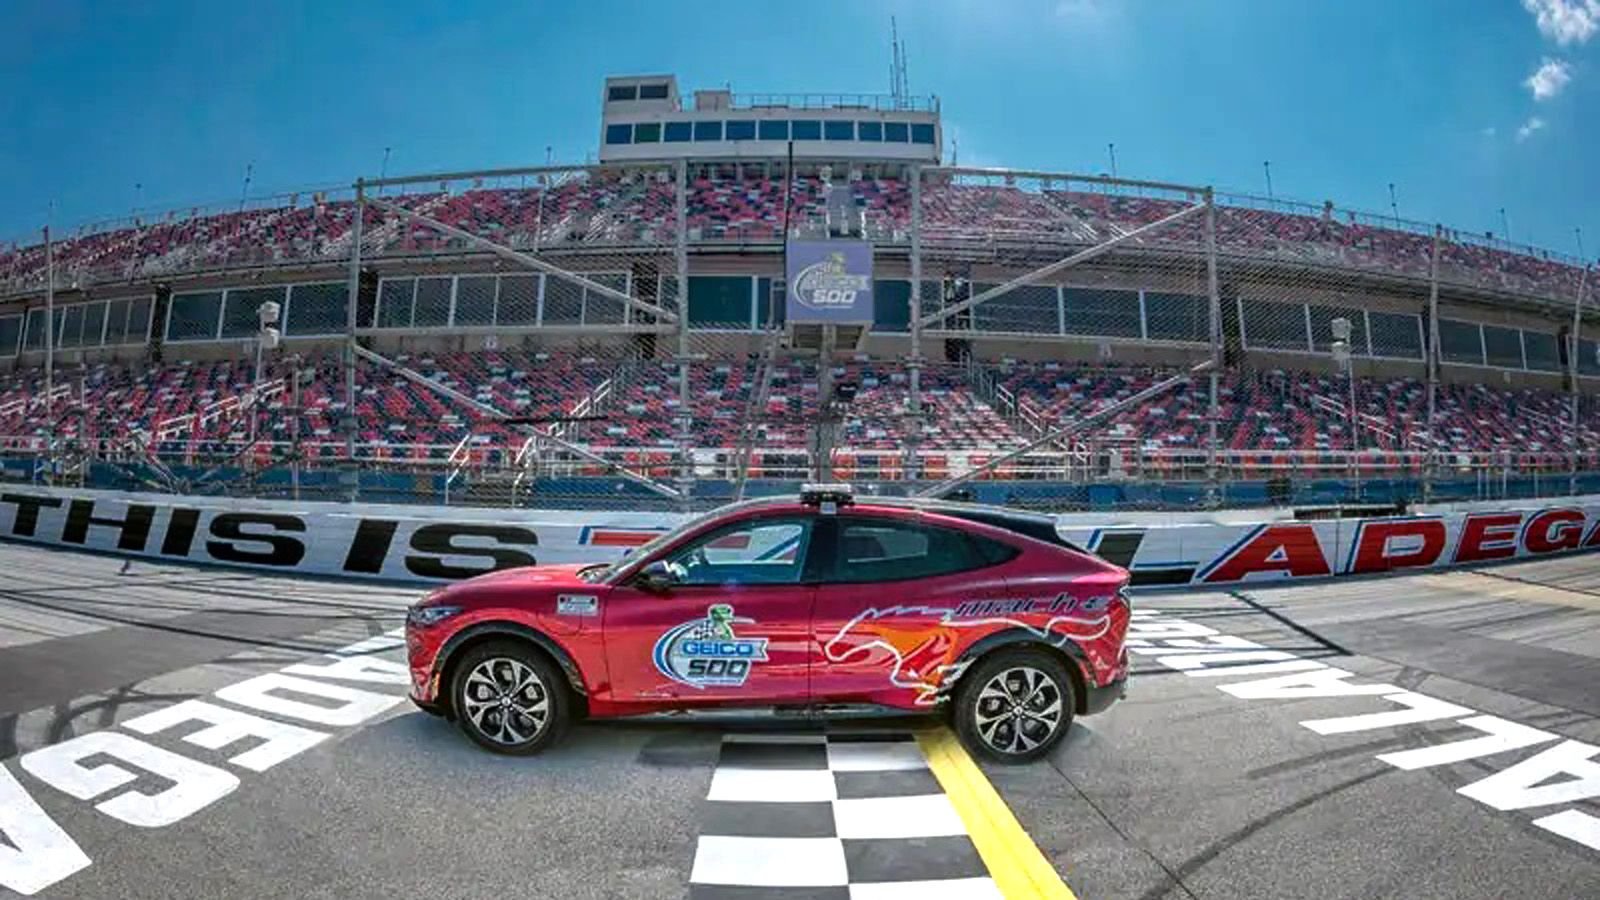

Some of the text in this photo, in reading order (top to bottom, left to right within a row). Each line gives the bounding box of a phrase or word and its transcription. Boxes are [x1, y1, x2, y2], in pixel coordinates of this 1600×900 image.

[814, 289, 857, 304] 500
[2, 493, 306, 566] THIS
[343, 519, 538, 579] IS
[683, 641, 754, 657] GEICO
[688, 660, 748, 678] 500
